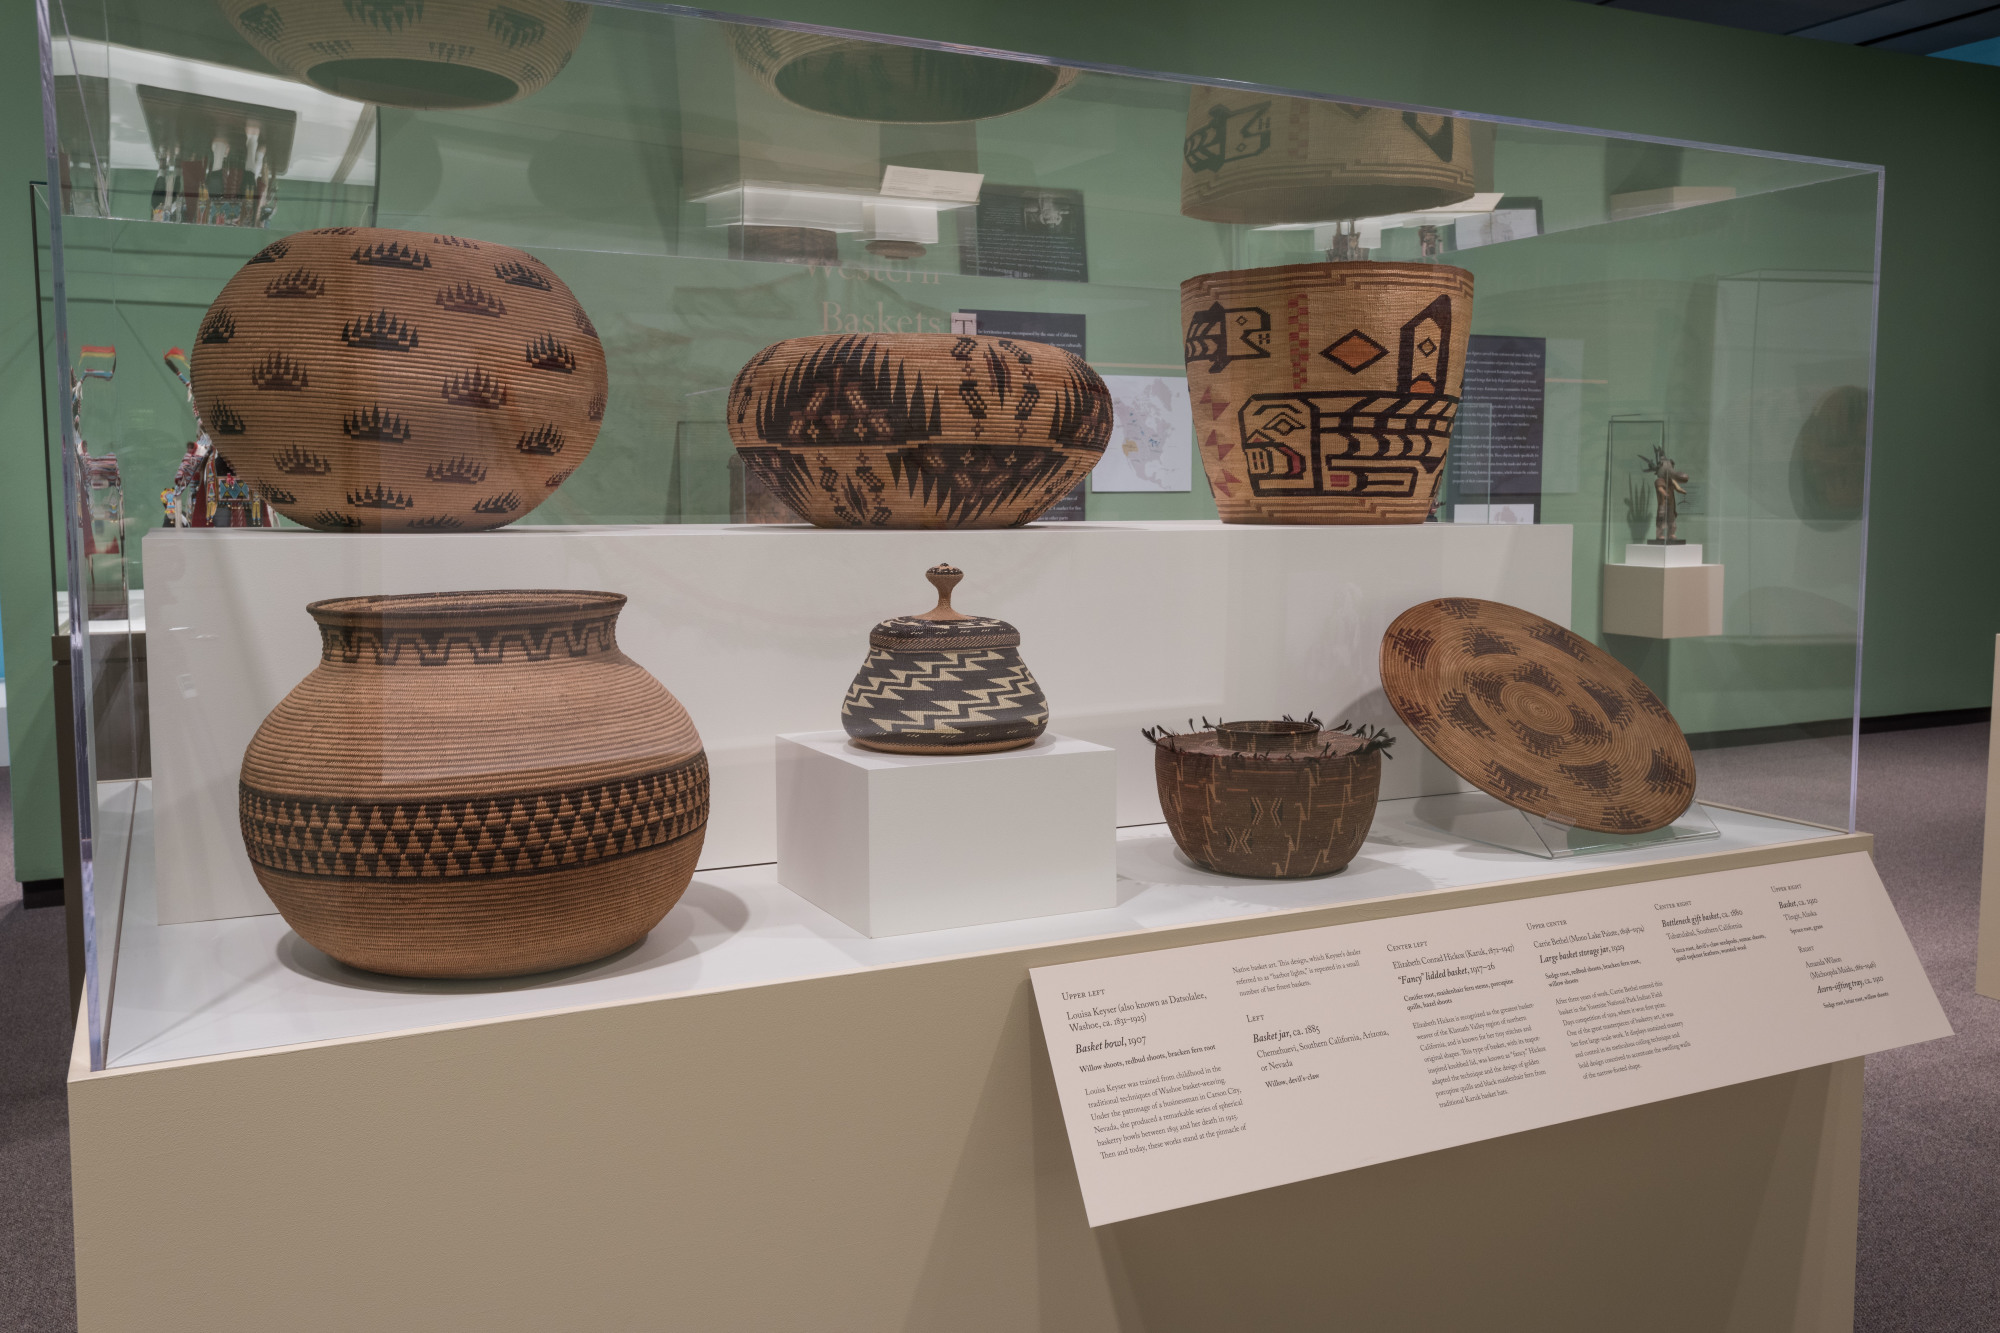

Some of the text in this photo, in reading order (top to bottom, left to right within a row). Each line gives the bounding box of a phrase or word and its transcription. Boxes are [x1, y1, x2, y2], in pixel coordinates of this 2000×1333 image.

[822, 301, 941, 334] Baskets
[1061, 989, 1104, 1000] UPPER LEFT
[1066, 1010, 1092, 1020] Louisa
[1092, 1007, 1117, 1017] Keyser
[1118, 1003, 1135, 1013] (also
[1135, 1001, 1160, 1009] known
[1168, 992, 1207, 1004] Datsolalee,
[1069, 1021, 1102, 1032] Washoe,
[1246, 1014, 1264, 1023] LEFT
[1253, 1032, 1280, 1043] Basket
[1279, 1031, 1292, 1041] jar,
[1305, 1024, 1321, 1035] 1885
[1299, 1040, 1328, 1051] Southern
[1328, 1034, 1362, 1046] California,
[1363, 1031, 1389, 1040] Arizona,
[1076, 1036, 1146, 1054] Basket bowl, 1907
[1079, 1064, 1102, 1072] Willow
[1103, 1061, 1124, 1069] shoots,
[1125, 1055, 1146, 1065] redbud
[1167, 1049, 1191, 1058] bracken
[1268, 1059, 1293, 1070] Nevada
[1265, 1080, 1288, 1088] Willow,
